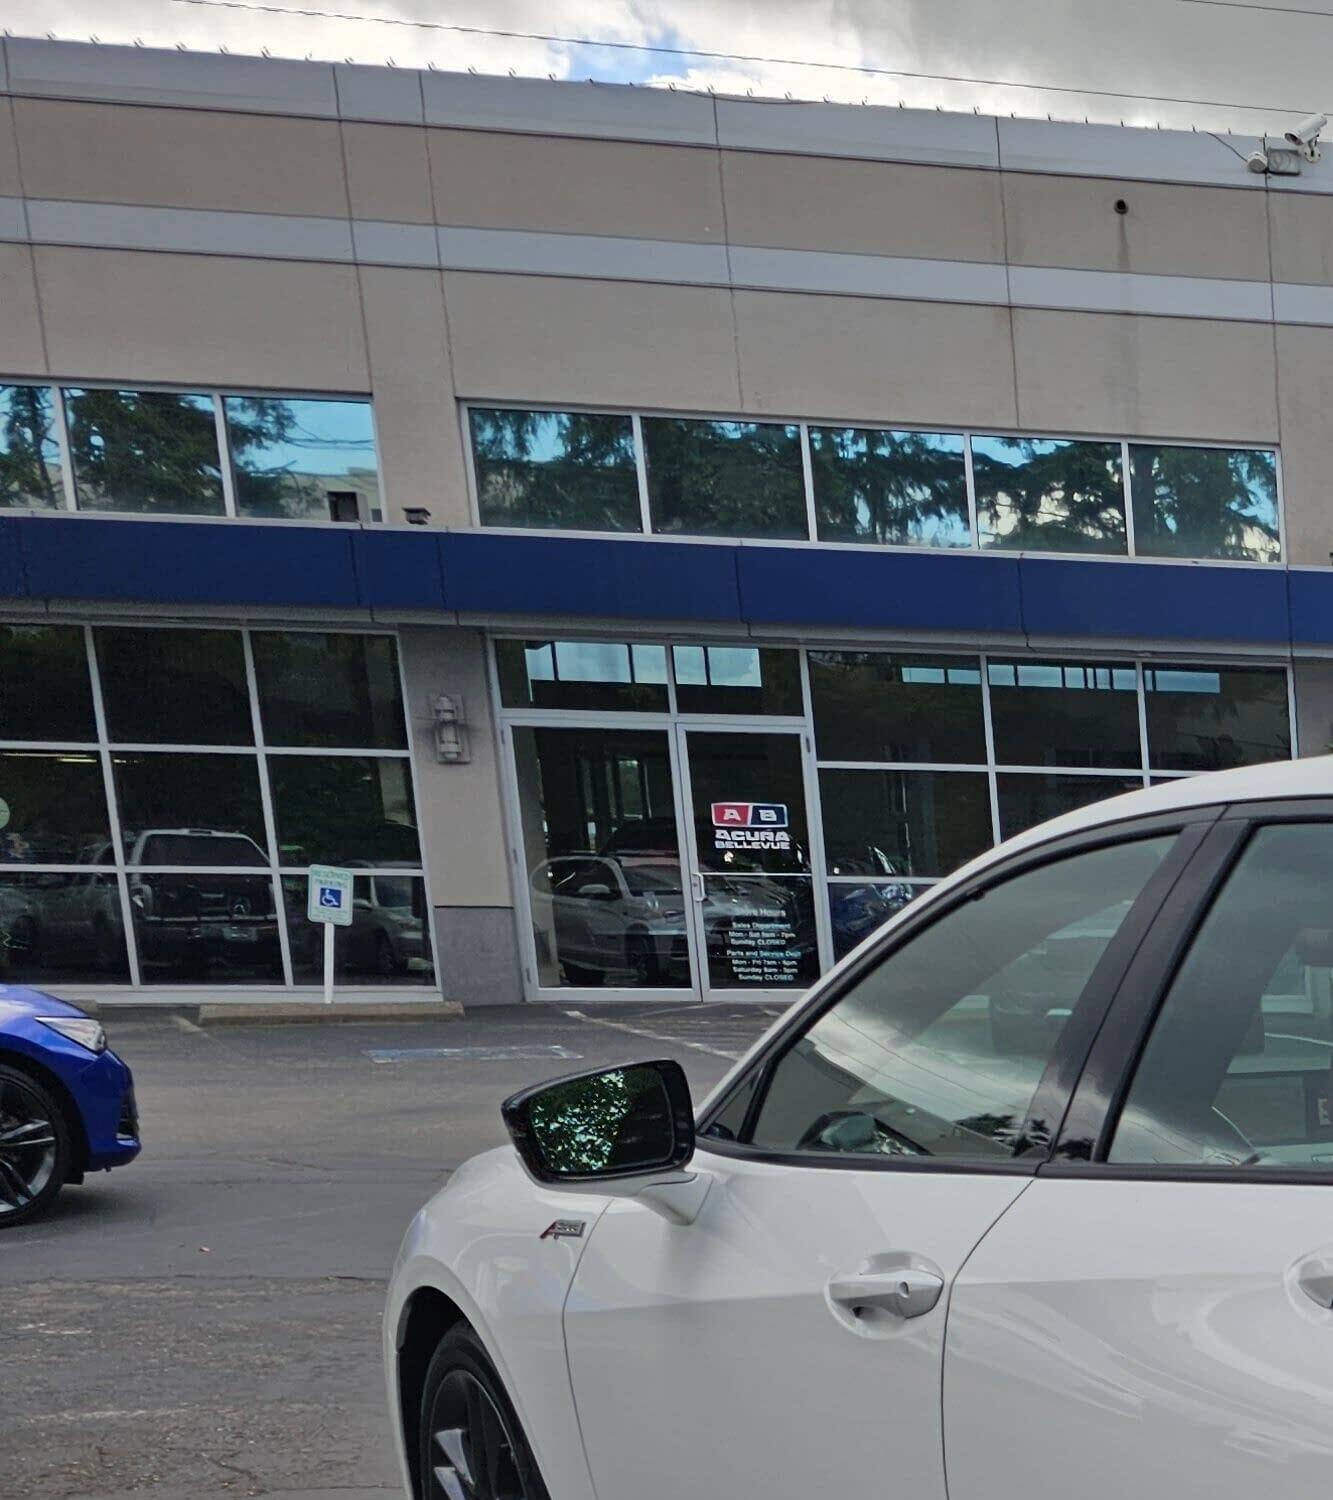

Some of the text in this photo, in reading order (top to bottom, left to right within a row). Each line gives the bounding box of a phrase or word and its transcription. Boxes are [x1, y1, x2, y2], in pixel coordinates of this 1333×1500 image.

[724, 808, 777, 822] A B
[715, 829, 790, 842] ACURA
[715, 840, 790, 850] BELLEVUE
